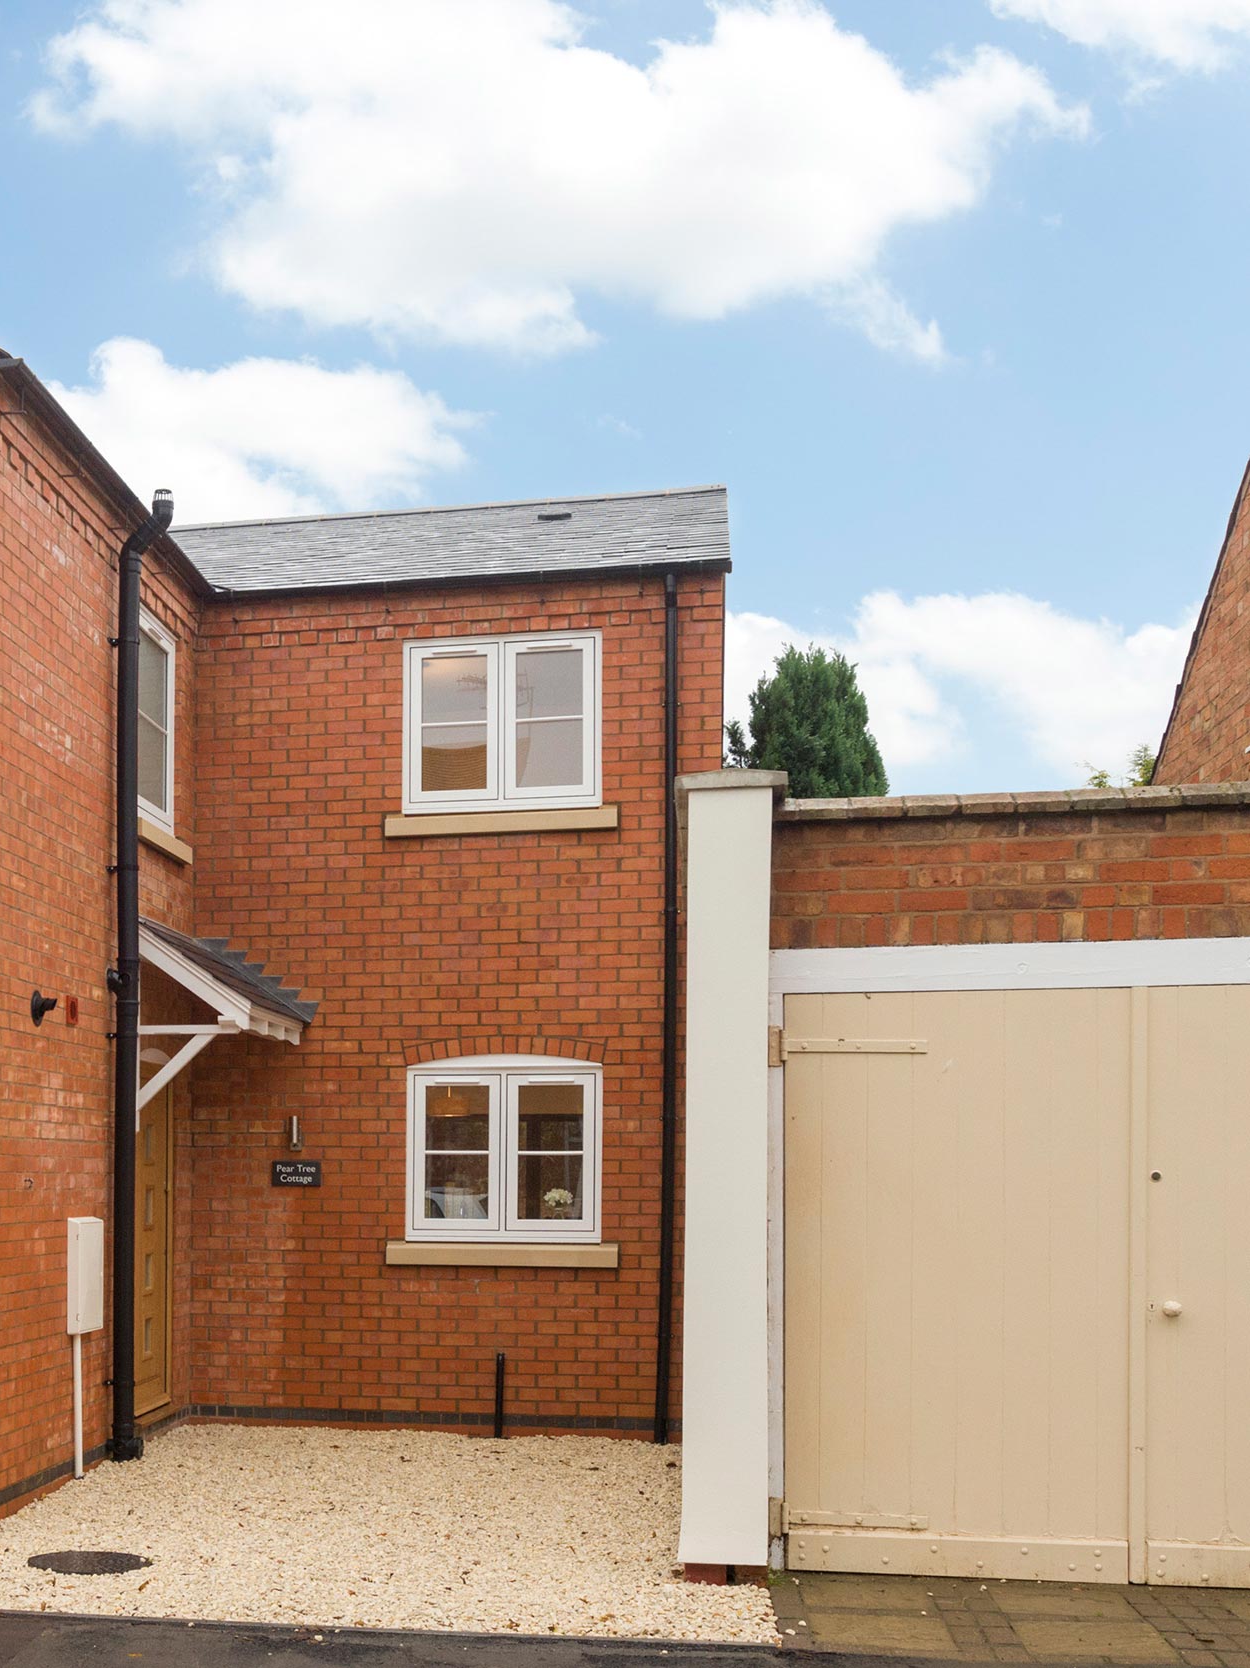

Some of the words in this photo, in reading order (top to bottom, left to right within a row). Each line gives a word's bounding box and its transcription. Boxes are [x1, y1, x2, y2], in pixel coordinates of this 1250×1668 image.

[276, 1164, 295, 1173] Pear
[297, 1164, 316, 1173] Tree
[280, 1174, 312, 1184] Cottage
